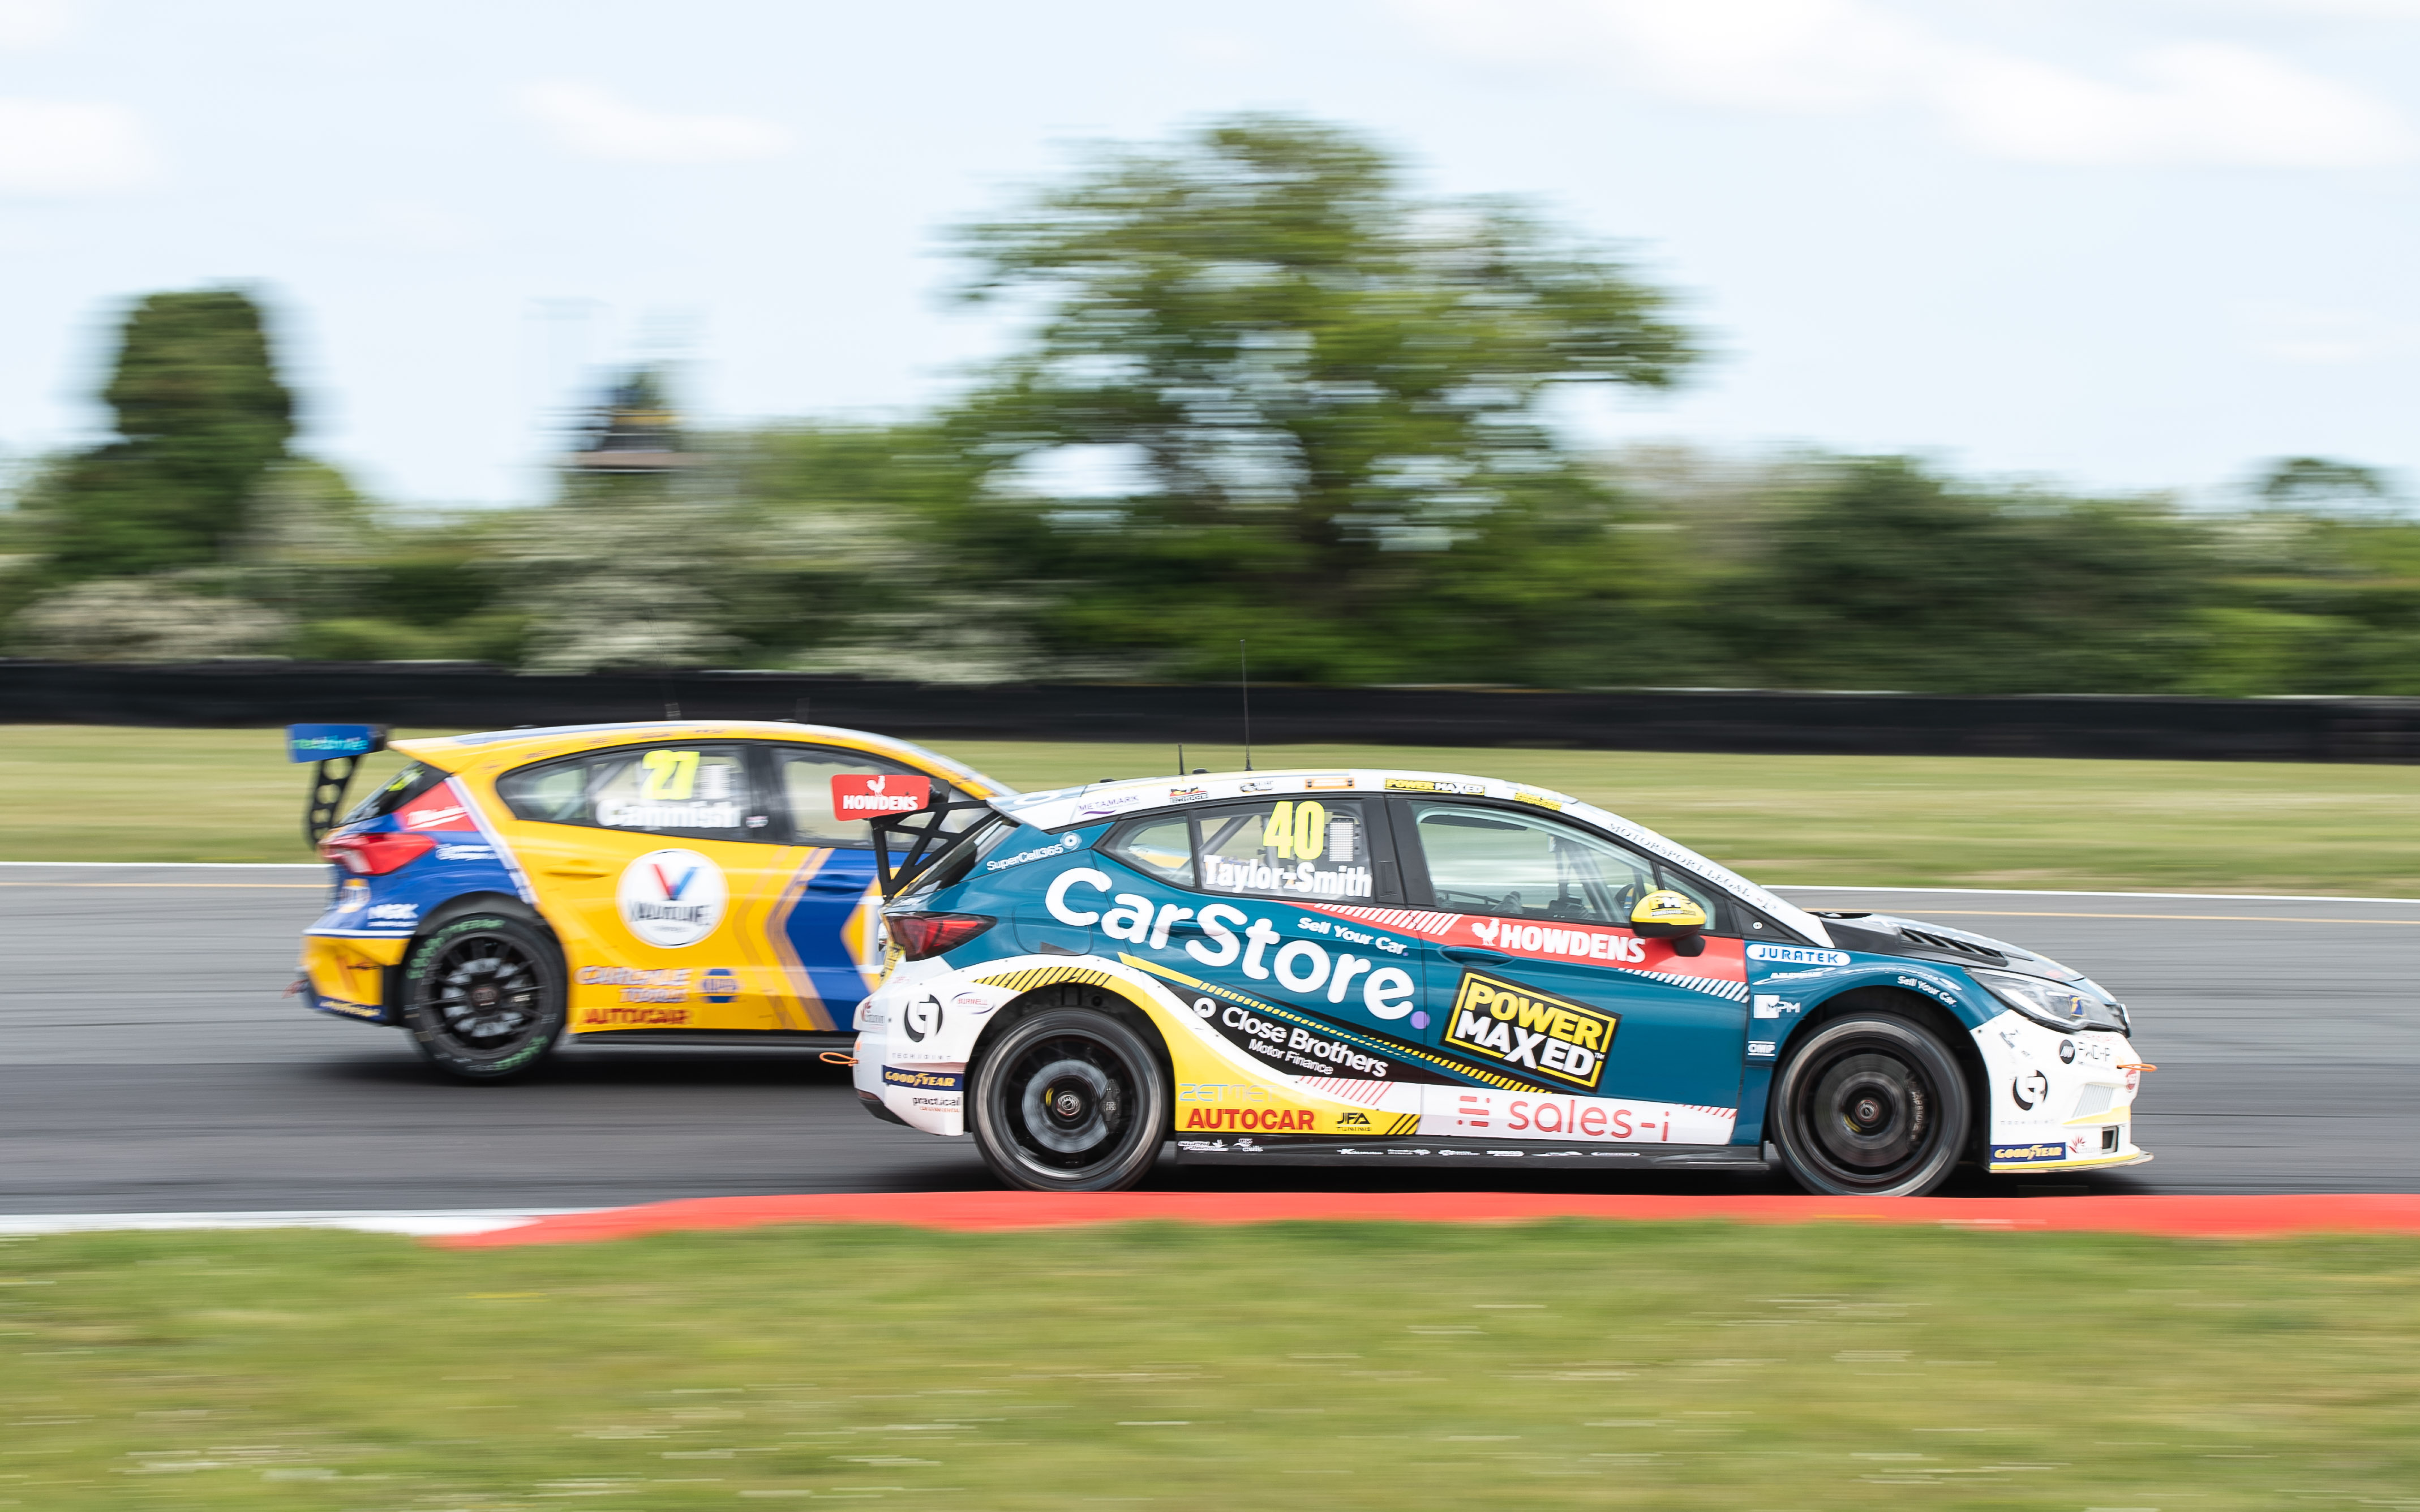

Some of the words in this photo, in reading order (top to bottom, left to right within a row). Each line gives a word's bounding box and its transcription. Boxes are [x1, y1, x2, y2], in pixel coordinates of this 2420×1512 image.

[641, 749, 701, 800] 27
[1386, 779, 1435, 790] POWER
[1435, 782, 1483, 794] MAXED
[843, 795, 918, 811] HOWDENS
[1263, 801, 1325, 860] 40
[986, 843, 1064, 871] SuperCell365
[1607, 823, 1703, 871] MOTORSPORT
[1706, 870, 1751, 897] LEGAL
[1203, 854, 1372, 897] Taylor-Smith
[1297, 917, 1331, 934] Sell
[1334, 925, 1374, 944] Your
[1500, 923, 1646, 963] HOWDENS
[1759, 947, 1839, 964] JURATEK
[1897, 976, 1917, 986] Sell
[1917, 980, 1941, 995] Your
[1464, 982, 1603, 1051] POWER
[1222, 1006, 1288, 1042] Close
[1288, 1028, 1389, 1077] Brothers
[1248, 1038, 1286, 1059] Motor
[1285, 1051, 1334, 1075] Finance
[1454, 1011, 1595, 1076] MAXED
[885, 1071, 956, 1087] GOODYEAR
[1186, 1108, 1315, 1131] AUTOCAR
[1336, 1112, 1371, 1124] JFA
[1508, 1099, 1669, 1142] sales-i
[1994, 1144, 2063, 1161] GOODYEAR
